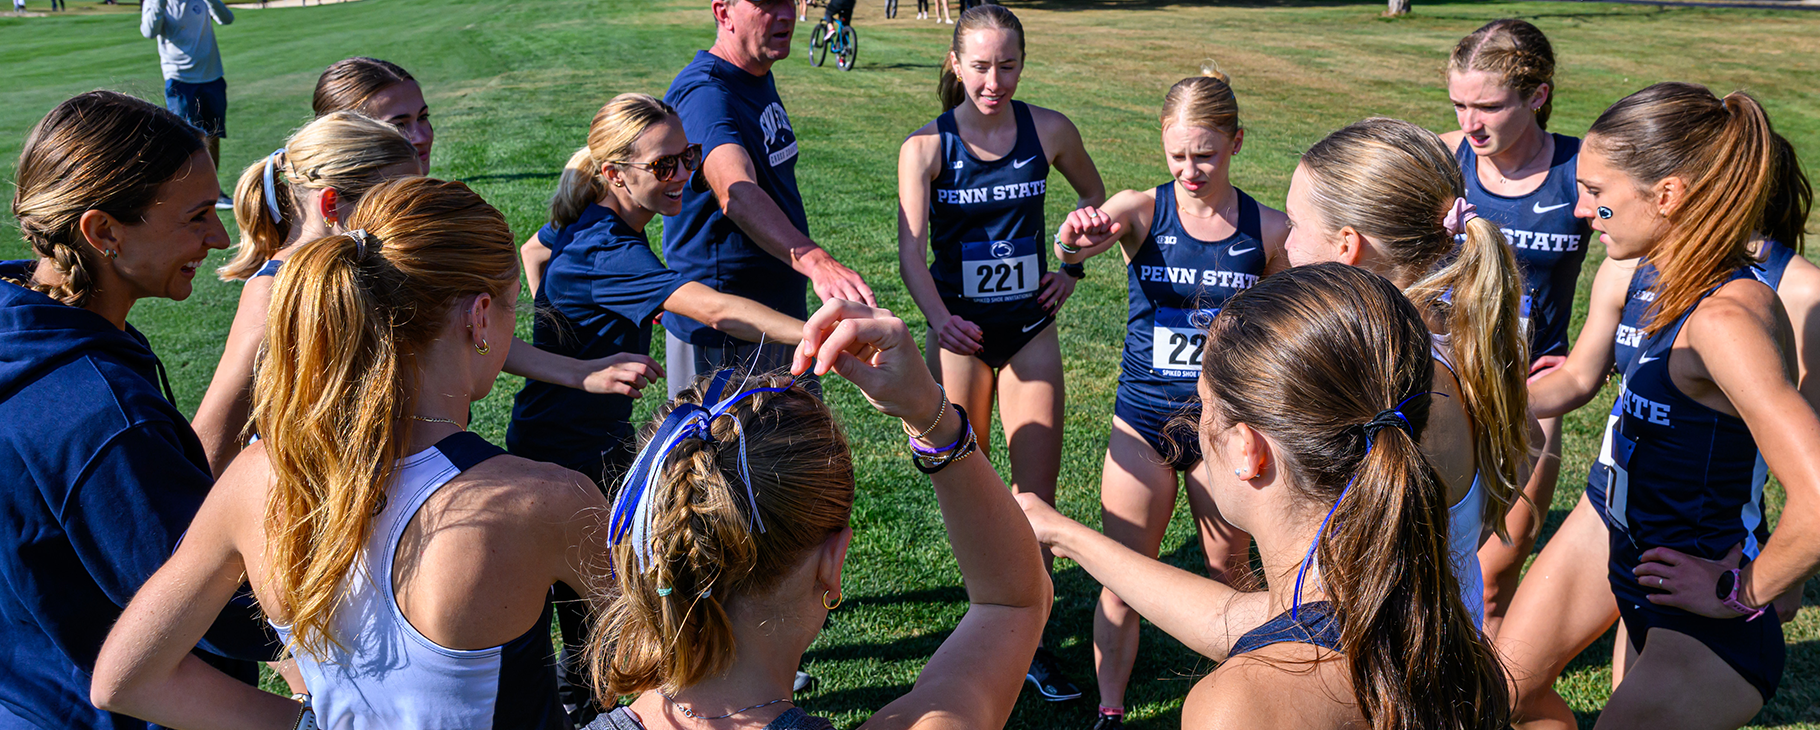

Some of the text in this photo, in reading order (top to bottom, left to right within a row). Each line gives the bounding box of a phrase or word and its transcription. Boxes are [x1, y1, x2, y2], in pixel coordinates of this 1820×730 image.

[937, 179, 1046, 205] PENN STATE
[1499, 227, 1582, 252] STATE
[976, 261, 1025, 294] 221
[1140, 265, 1197, 285] PENN
[1168, 332, 1207, 366] 22
[1162, 369, 1182, 377] SPIKED
[1182, 370, 1197, 378] SHOE
[1622, 387, 1671, 427] ATE
